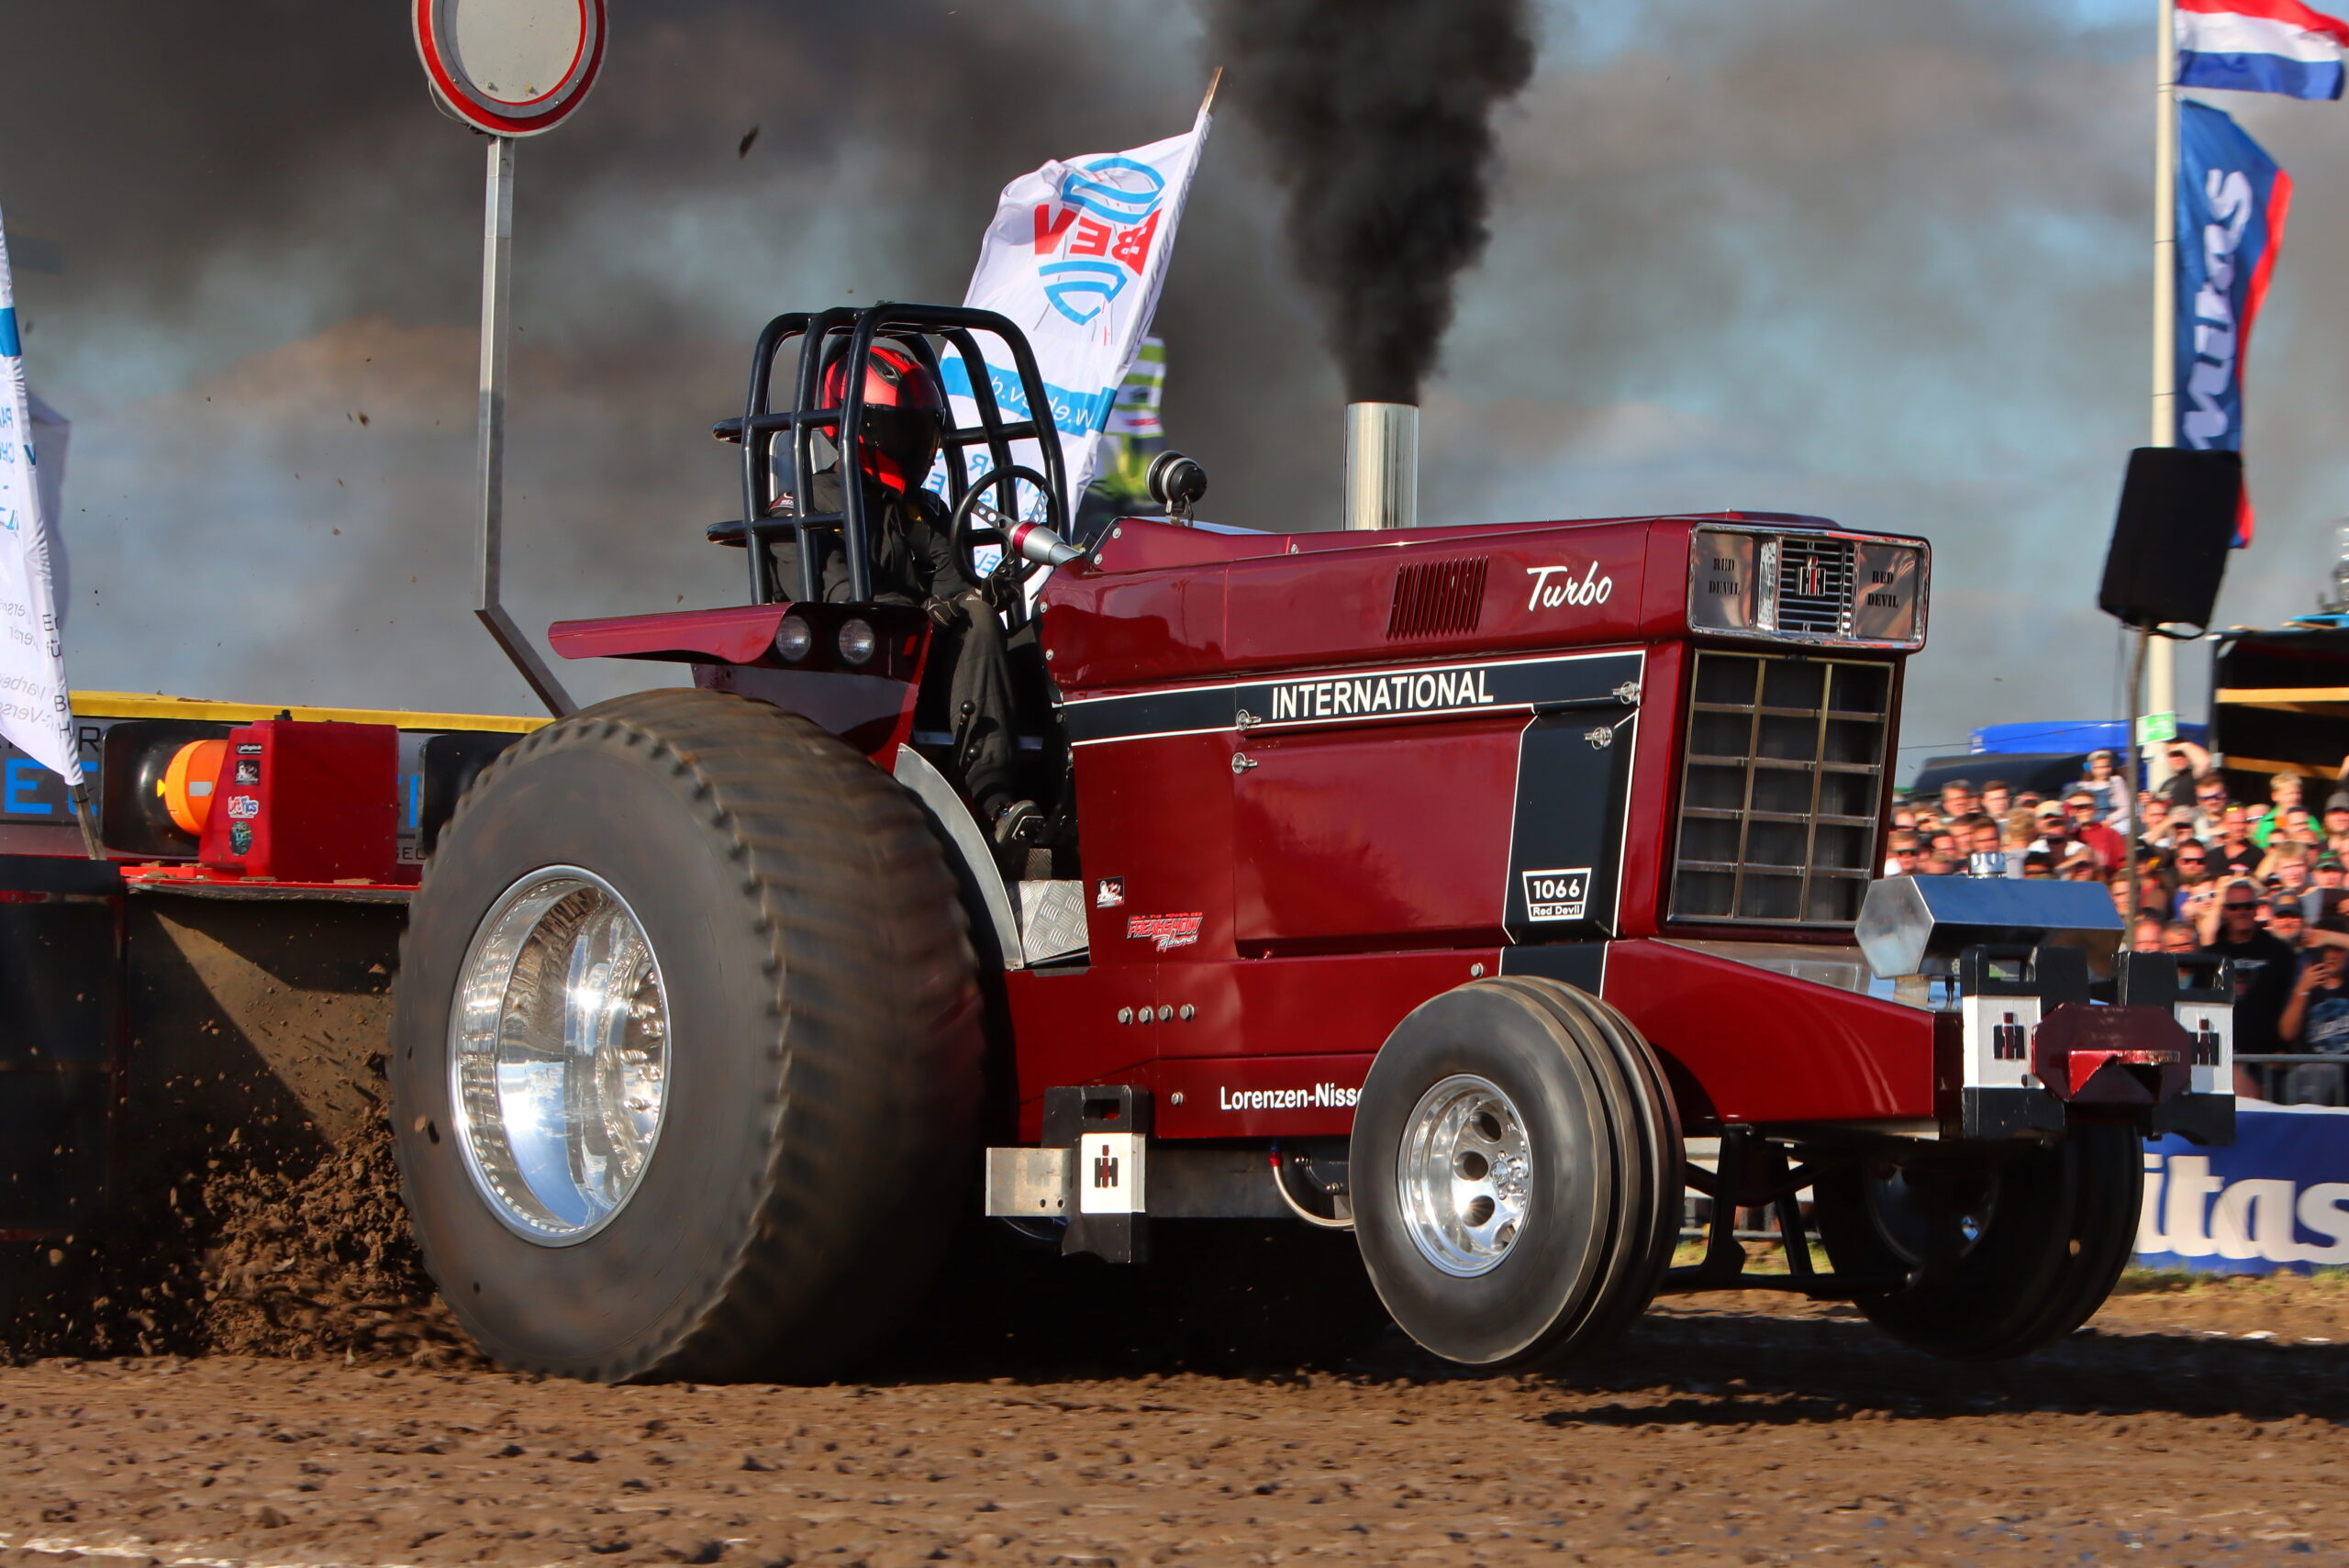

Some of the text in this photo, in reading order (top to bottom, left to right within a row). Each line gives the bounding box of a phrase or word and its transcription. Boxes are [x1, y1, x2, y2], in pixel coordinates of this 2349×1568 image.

[1713, 557, 1735, 572] RED
[1872, 571, 1894, 584] RED
[1526, 560, 1612, 612] Turbo
[1709, 580, 1741, 595] DEVIL
[1866, 593, 1899, 608] DEVIL
[1272, 670, 1494, 720] INTERNATIONAL
[1532, 878, 1580, 899] 1066
[1532, 905, 1580, 916] Red Devil
[1127, 917, 1203, 939] FREAKSHOW
